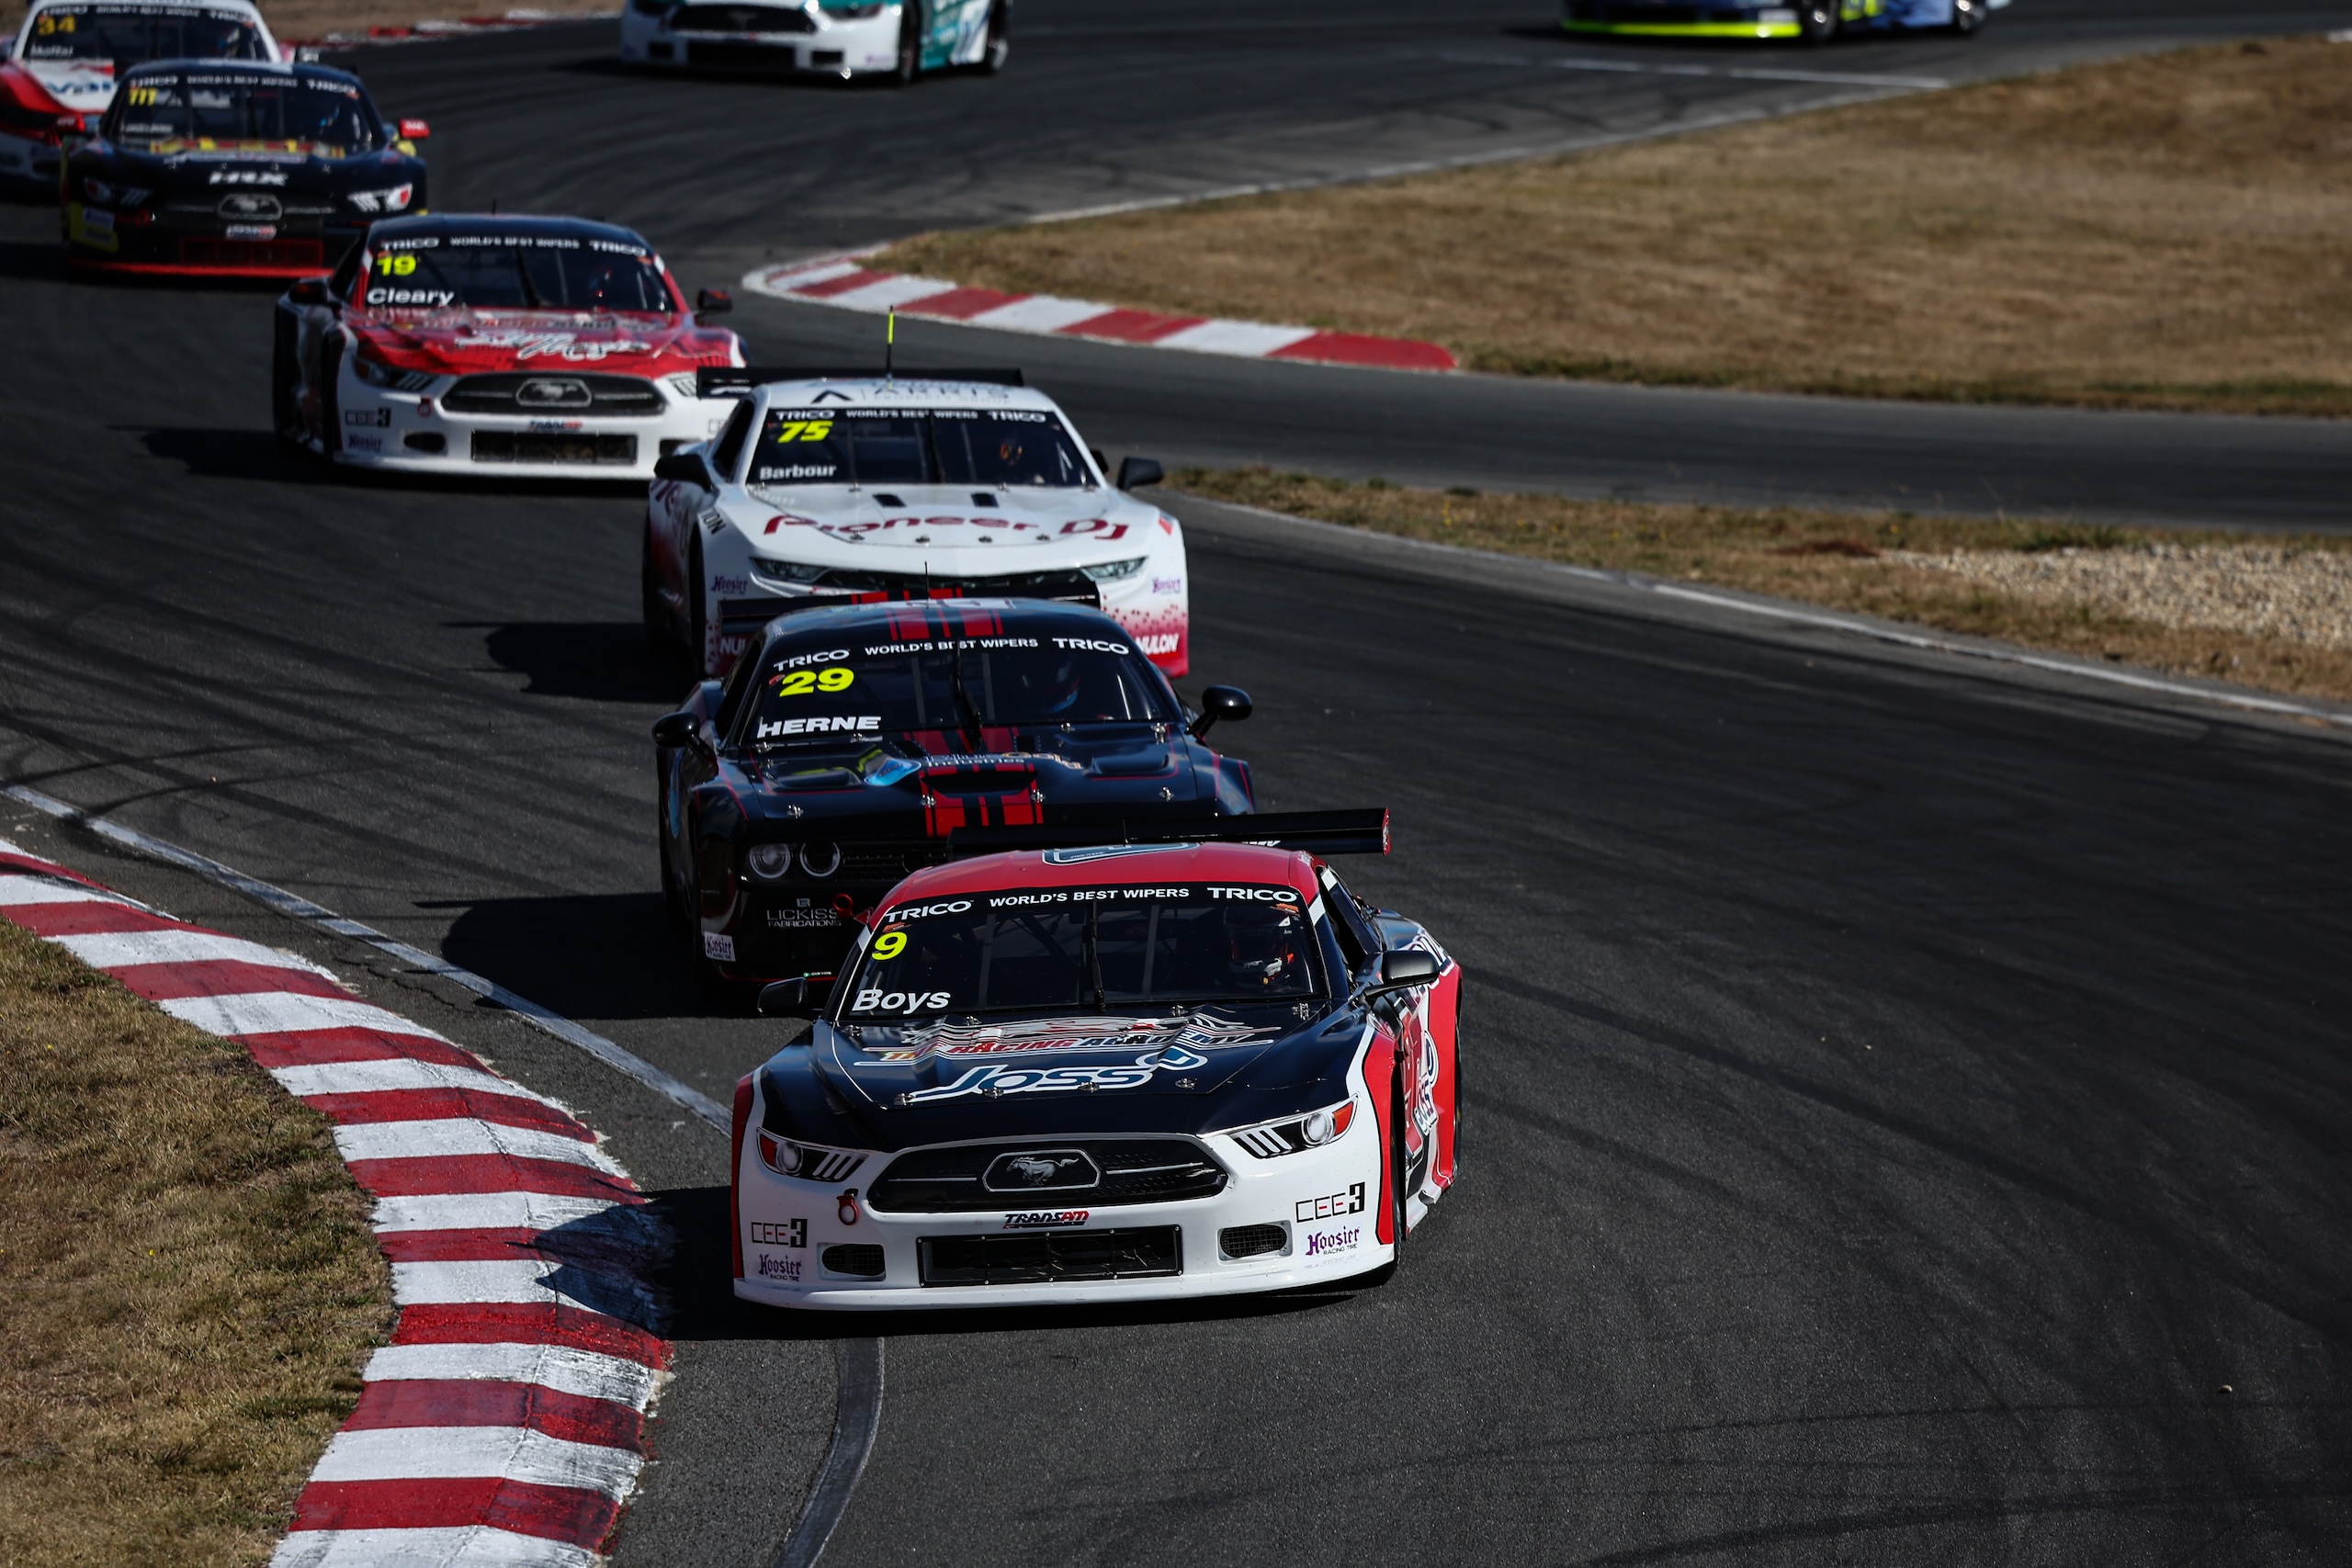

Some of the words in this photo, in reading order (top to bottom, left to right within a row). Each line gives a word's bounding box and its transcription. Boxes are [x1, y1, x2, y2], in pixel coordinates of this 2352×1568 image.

[38, 16, 76, 36] 34
[381, 237, 440, 251] TRICO
[449, 236, 502, 247] WORLD'S
[536, 237, 581, 250] WIPERS
[588, 240, 647, 256] TRICO
[377, 254, 417, 276] 19
[367, 287, 455, 307] Cleary
[775, 410, 836, 421] TRICO
[846, 409, 899, 419] WORLD'S
[933, 410, 978, 421] WIPERS
[987, 411, 1046, 423] TRICO
[777, 420, 833, 444] 75
[759, 463, 837, 480] Barbour
[1059, 518, 1130, 540] DJ
[774, 649, 851, 672] TRICO
[865, 642, 933, 656] WORLD'S
[980, 638, 1039, 649] WIPERS
[1052, 637, 1130, 656] TRICO
[779, 667, 854, 697] 29
[756, 716, 882, 739] HERNE
[766, 908, 838, 920] LICKISS
[886, 900, 973, 923] TRICO
[989, 891, 1068, 908] WORLD'S
[1073, 889, 1118, 901] BEST
[1123, 888, 1190, 898] WIPERS
[1206, 886, 1298, 903] TRICO
[767, 919, 842, 928] FABRICATIONS
[871, 931, 908, 961] 9
[851, 987, 952, 1015] Boys
[946, 1037, 1079, 1055] RACING
[1306, 1225, 1360, 1256] Hoosier
[1323, 1246, 1345, 1256] RACING
[759, 1254, 802, 1276] Hoosier
